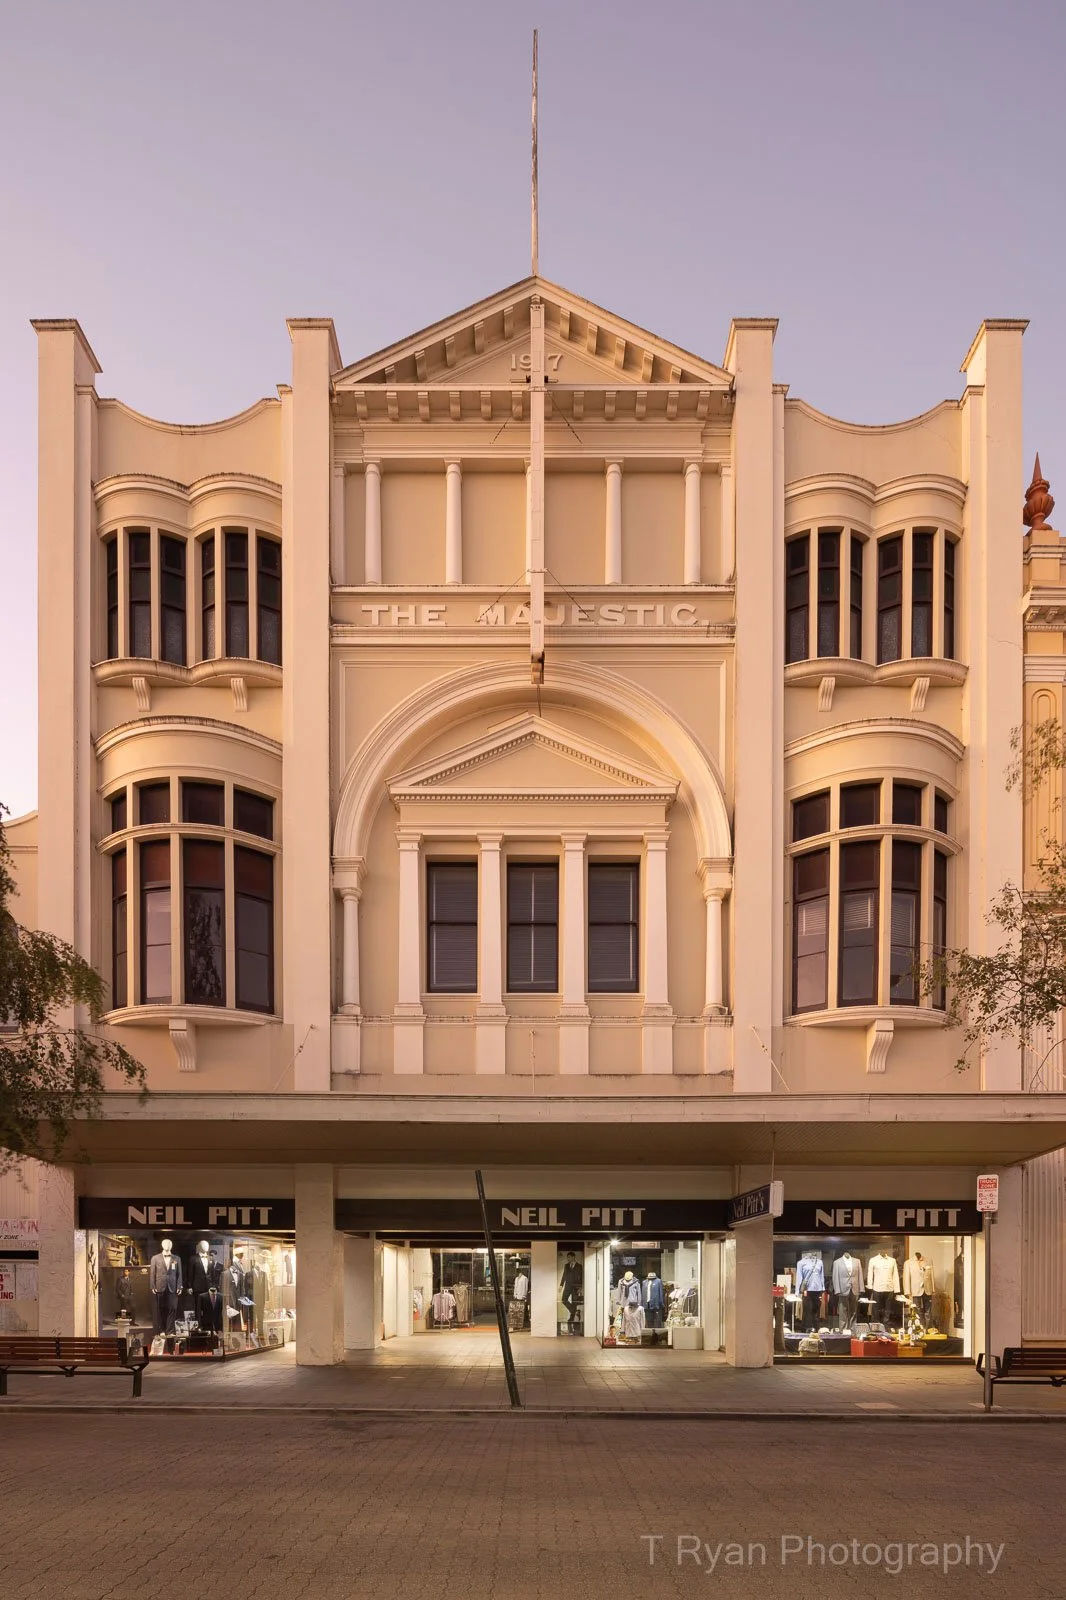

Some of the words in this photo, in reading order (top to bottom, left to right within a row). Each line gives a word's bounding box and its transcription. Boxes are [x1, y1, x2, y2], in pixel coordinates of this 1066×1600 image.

[510, 353, 564, 371] 197
[361, 604, 447, 626] THE
[128, 1206, 192, 1225] NEIL
[208, 1206, 272, 1225] PITT
[501, 1207, 566, 1226] NEIL
[582, 1207, 646, 1226] PITT
[815, 1208, 880, 1227] NEIL
[896, 1208, 961, 1227] PITT
